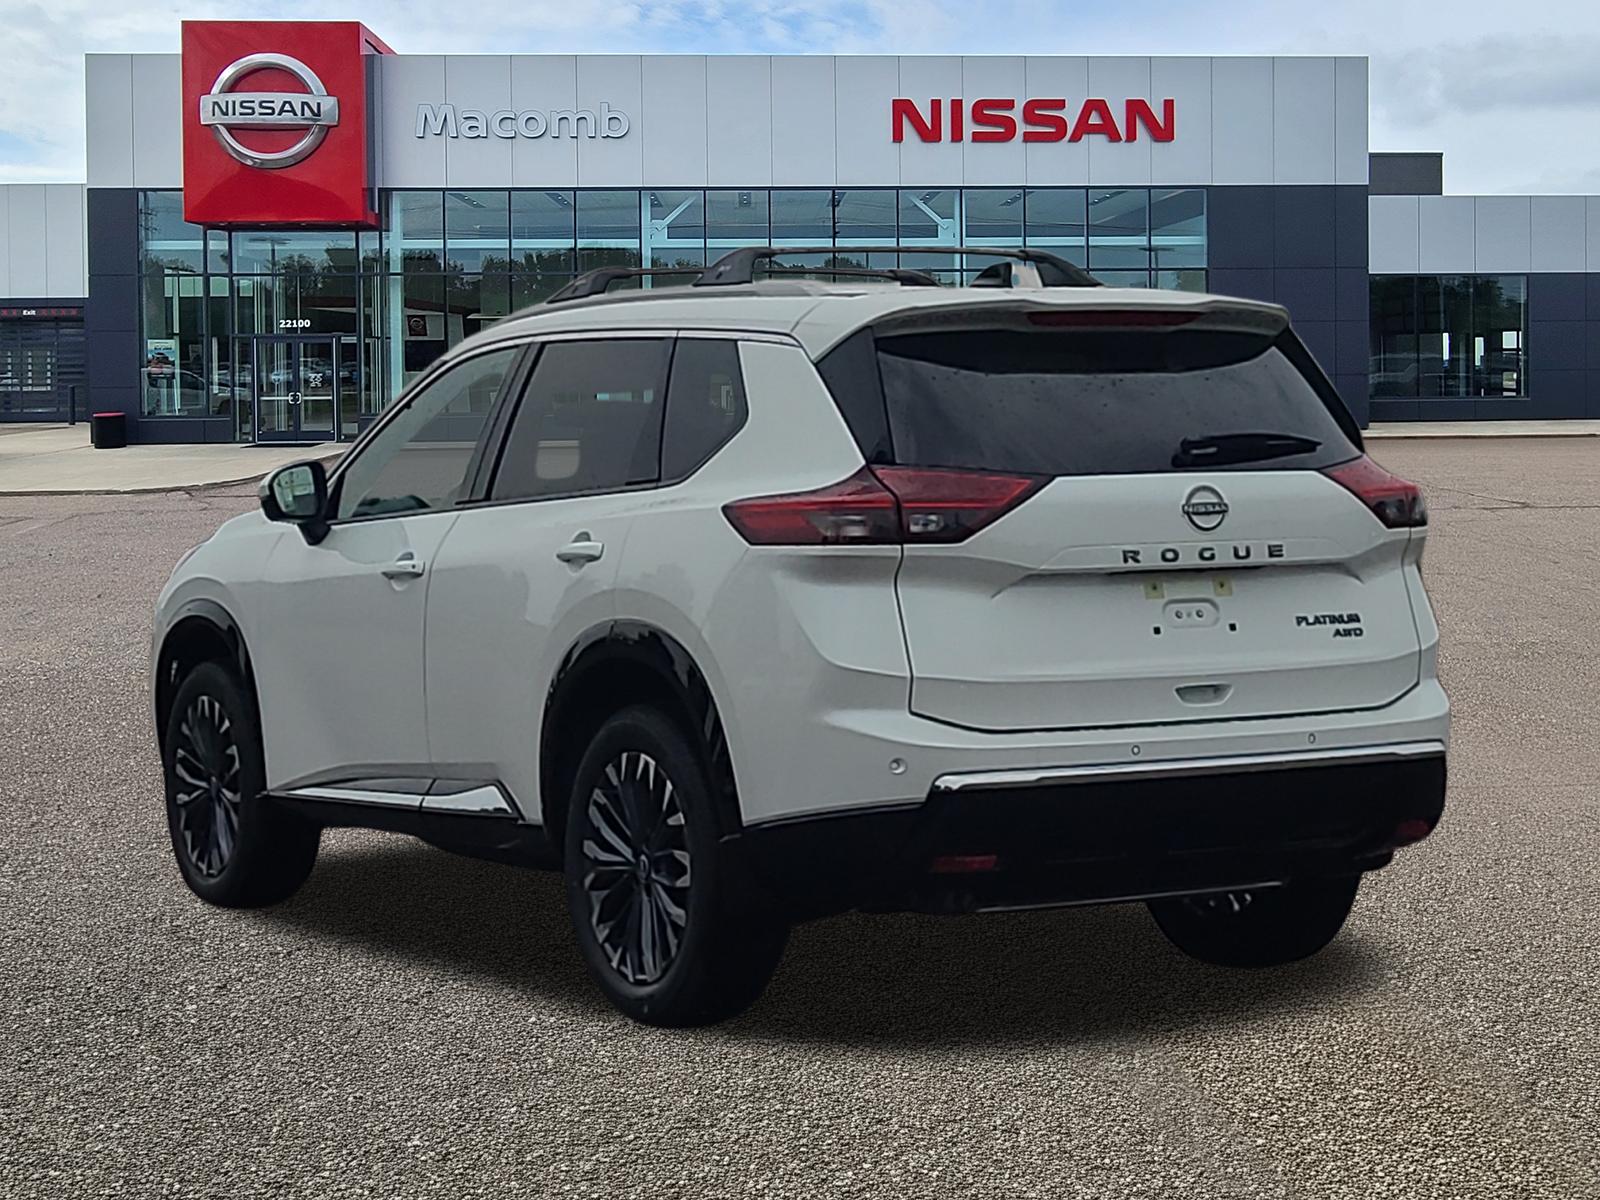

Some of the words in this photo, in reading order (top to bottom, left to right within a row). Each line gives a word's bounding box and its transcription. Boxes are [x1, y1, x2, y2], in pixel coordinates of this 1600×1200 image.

[212, 99, 322, 117] NISSAN
[415, 102, 630, 139] Macomb
[892, 98, 1175, 143] NISSAN
[279, 319, 311, 328] 22100
[1121, 544, 1284, 564] ROGUE
